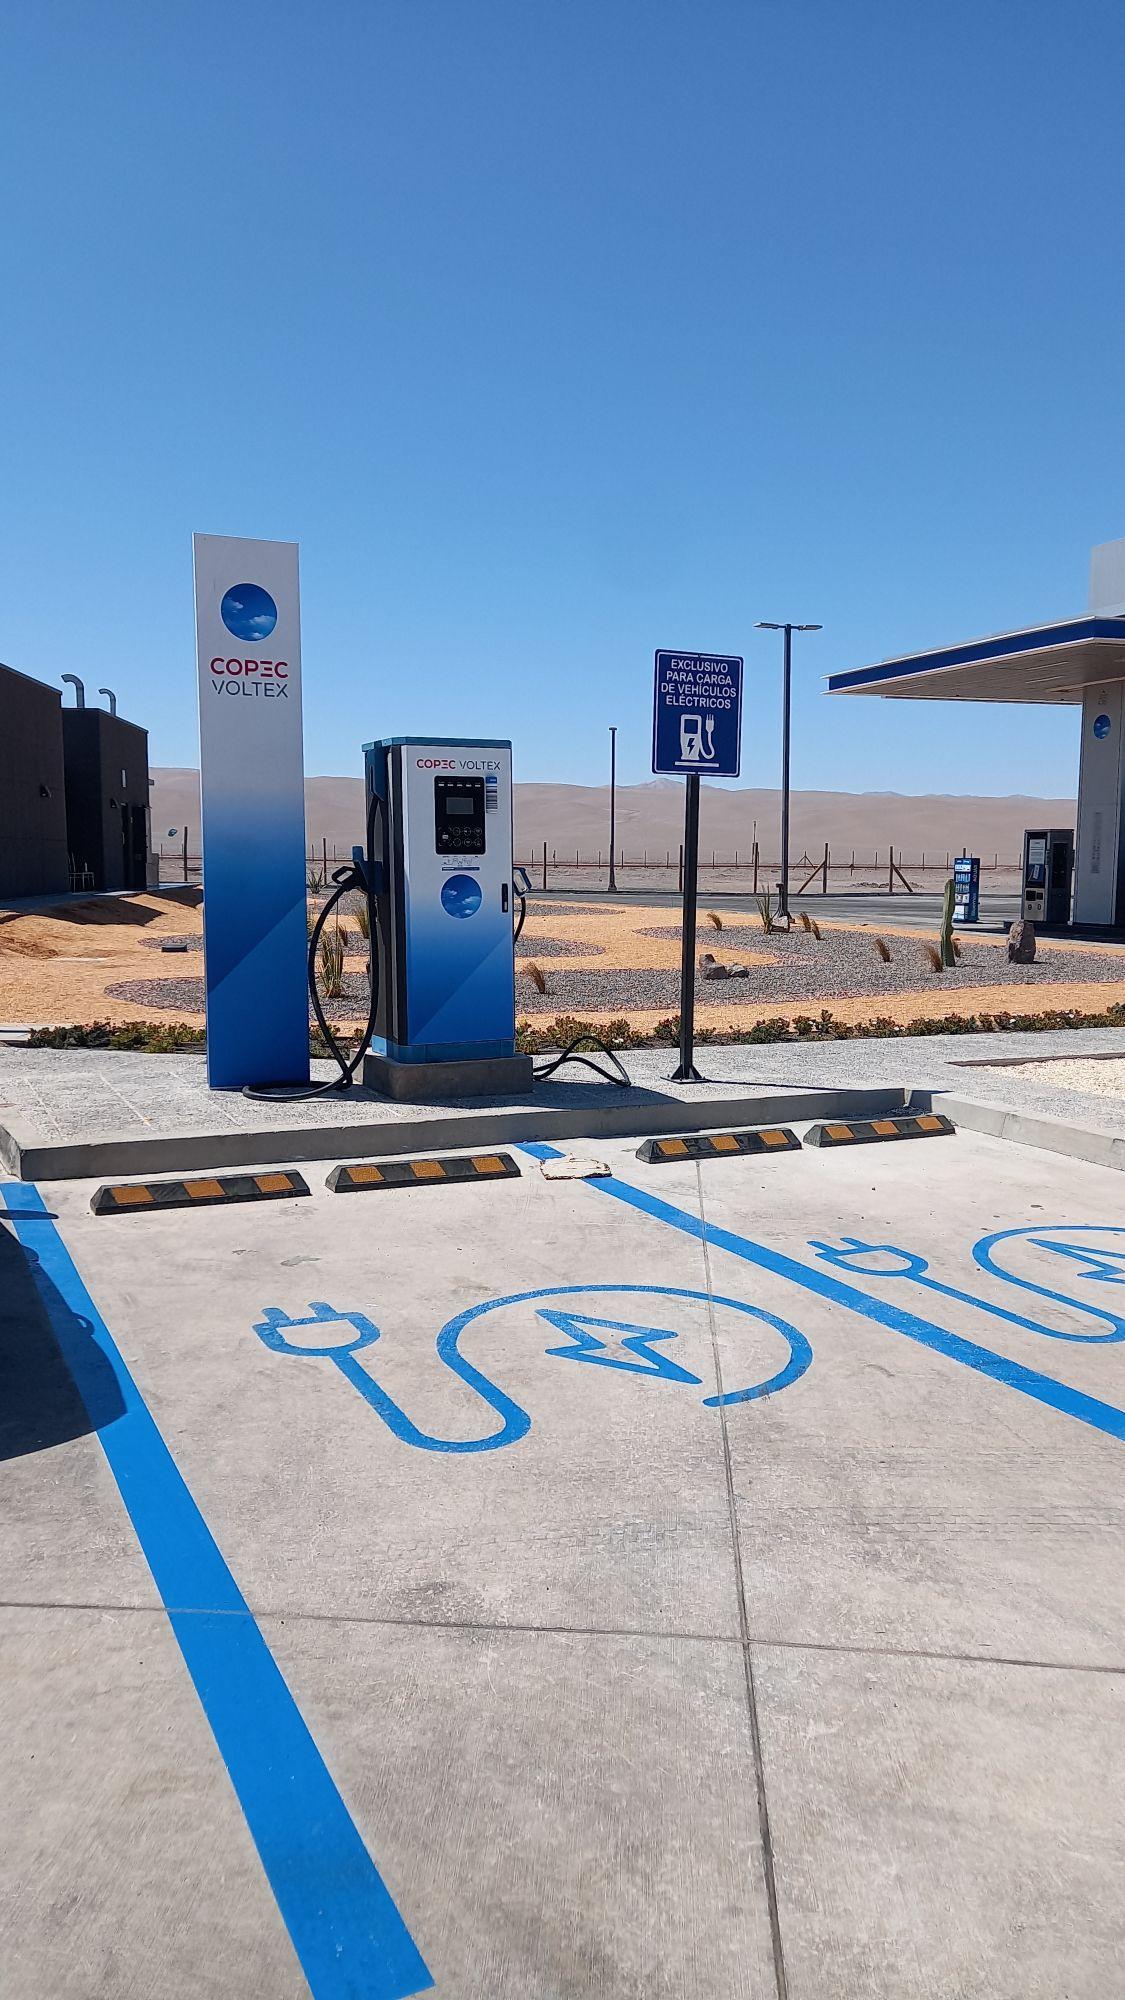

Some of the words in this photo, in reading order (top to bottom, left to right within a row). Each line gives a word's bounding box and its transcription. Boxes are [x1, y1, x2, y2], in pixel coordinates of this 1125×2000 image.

[210, 657, 288, 678] COPEC
[671, 659, 728, 673] EXCLUSIVO
[666, 671, 694, 683] PARA
[696, 673, 732, 685] CARGA
[211, 679, 288, 698] VOLTEX
[661, 682, 675, 693] DE
[677, 683, 737, 697] VEHÍCULOS
[666, 694, 731, 709] ELÉCTRICOS
[416, 759, 456, 770] COPEC
[459, 760, 501, 771] VOLTEX
